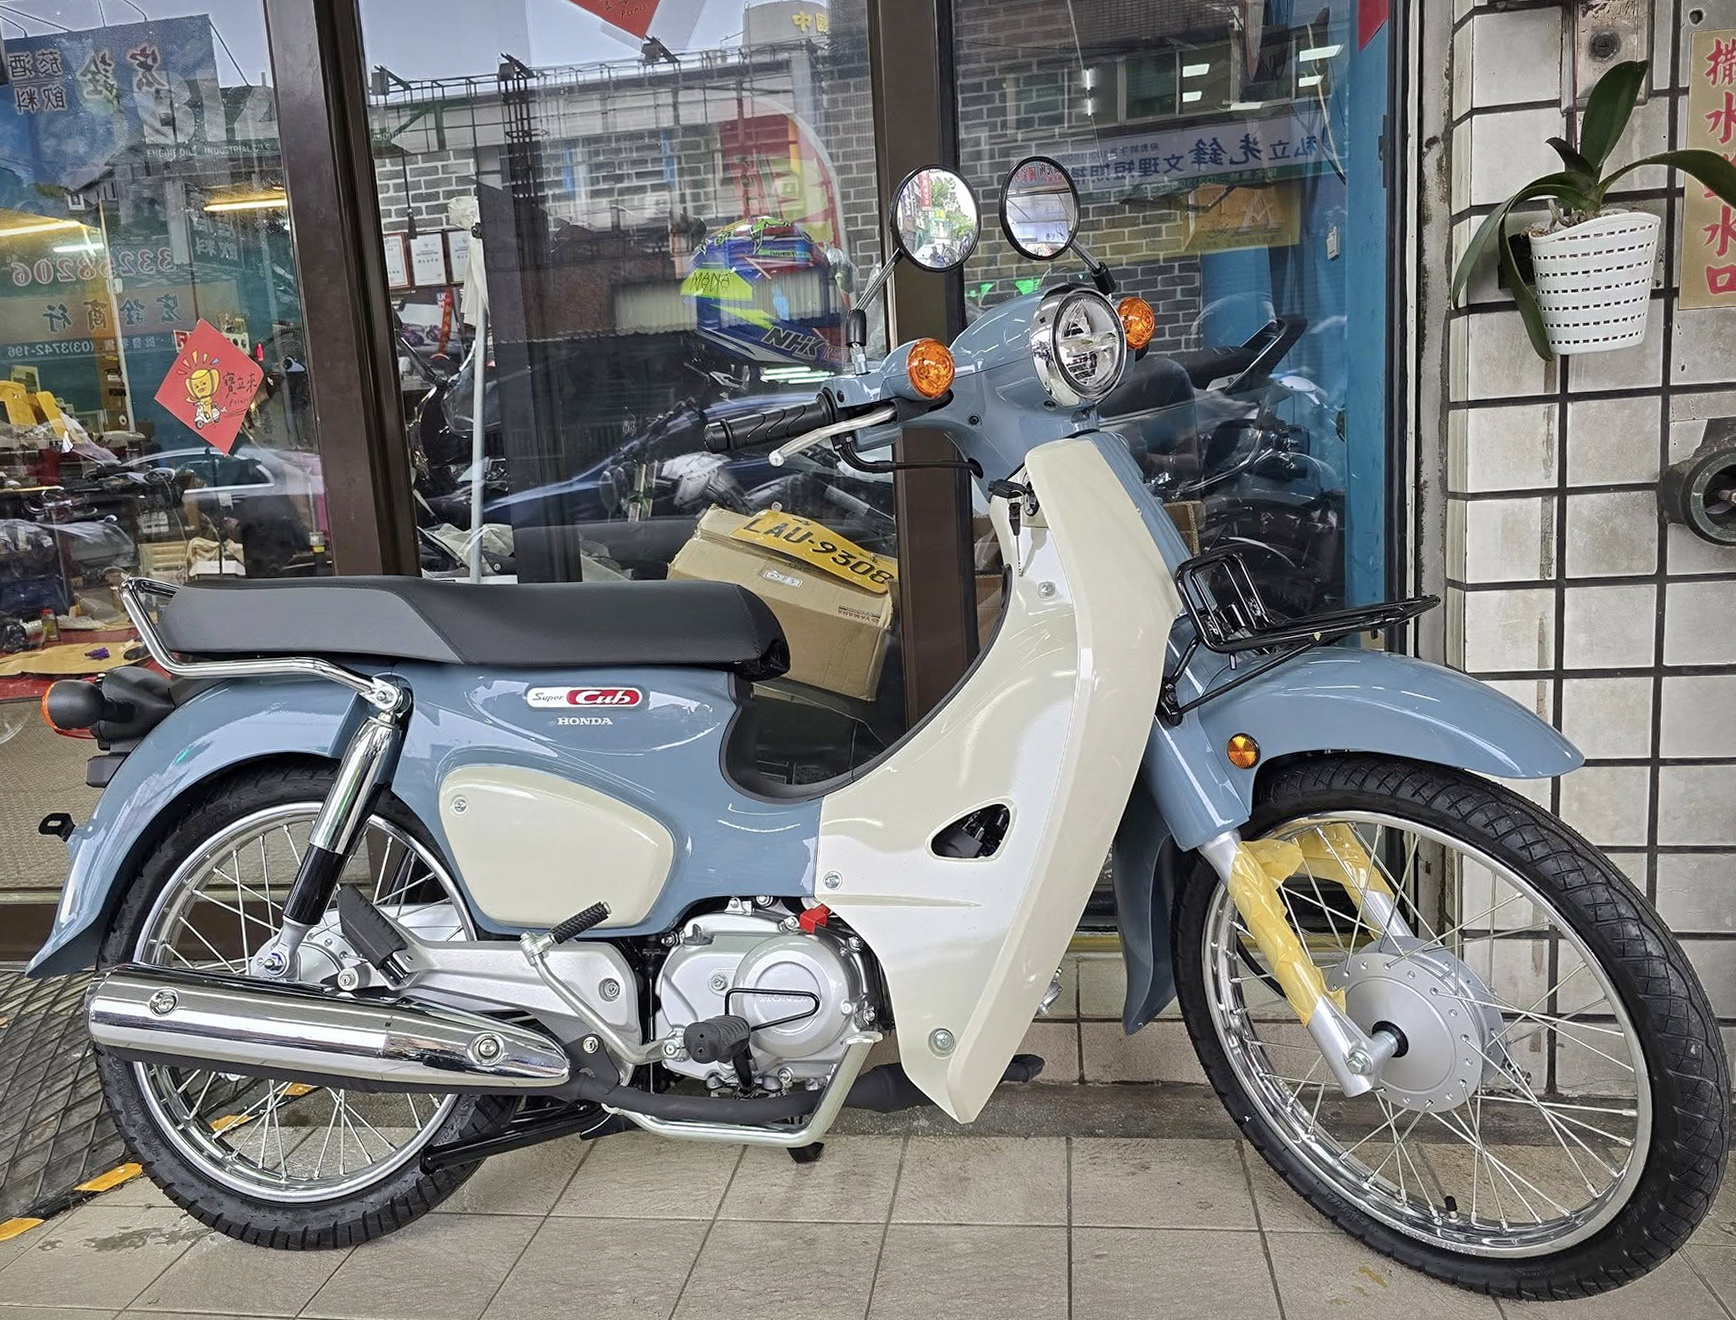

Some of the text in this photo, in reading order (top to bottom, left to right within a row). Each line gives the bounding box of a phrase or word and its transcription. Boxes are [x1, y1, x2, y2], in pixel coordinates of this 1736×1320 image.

[204, 145, 251, 155] INDUSTRIAL
[1704, 38, 1736, 295] 撒水水口
[761, 326, 827, 361] NHK
[743, 518, 895, 585] LAU-9308
[532, 690, 632, 706] Super Cub
[557, 717, 614, 726] HONDA
